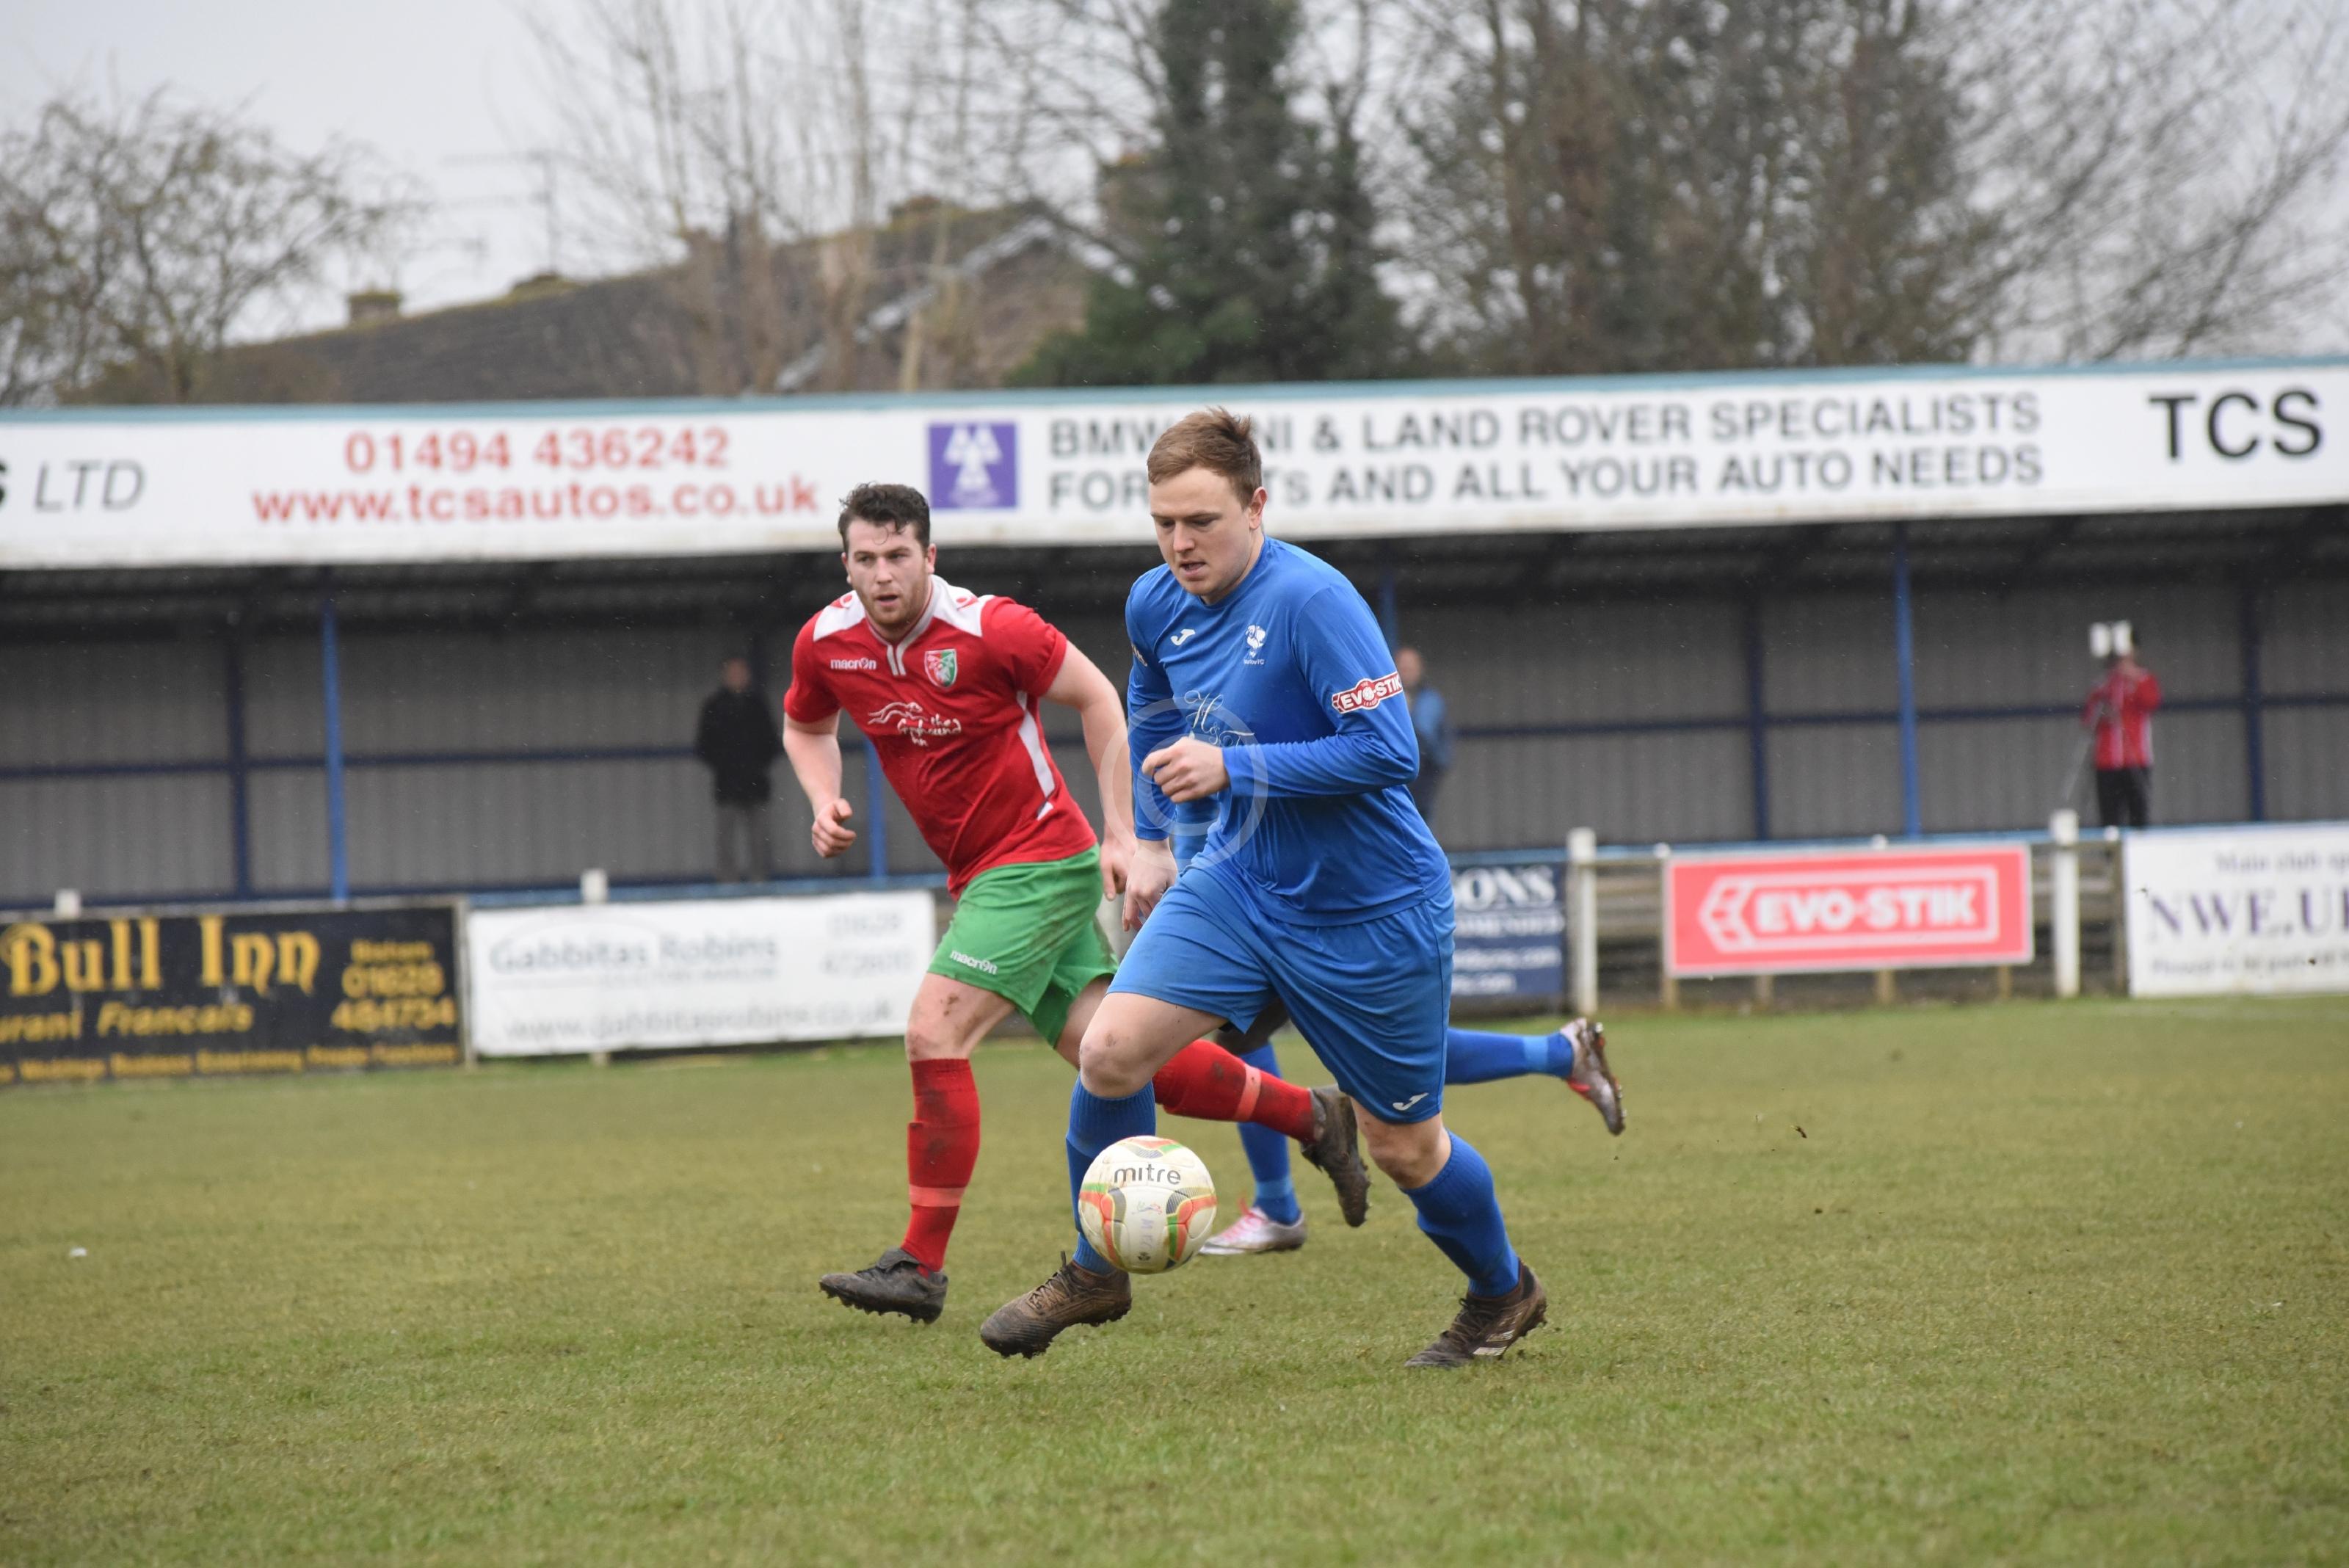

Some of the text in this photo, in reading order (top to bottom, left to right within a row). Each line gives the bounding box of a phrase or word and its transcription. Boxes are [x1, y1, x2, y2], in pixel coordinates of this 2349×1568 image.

[1313, 415, 1342, 453] &
[1363, 410, 1500, 451] LAND
[1521, 403, 1691, 445] ROVER
[1710, 391, 2041, 441] SPECIALISTS
[2149, 388, 2324, 460] TCS
[345, 427, 730, 473] 01494 436242
[33, 460, 145, 512] LTD
[252, 472, 818, 523] www.tcsautos.co.uk
[1049, 470, 1147, 512] FOR
[1328, 464, 1434, 503] AND
[1453, 461, 1544, 501] ALL
[1559, 454, 1699, 498] YOUR
[1718, 449, 1854, 493] AUTO
[1871, 443, 2043, 488] NEEDS
[830, 657, 876, 669] macron
[1755, 885, 1978, 934] EVO-STIK
[1, 915, 161, 997] Bull
[950, 950, 998, 976] macron
[1114, 1163, 1181, 1186] mitre
